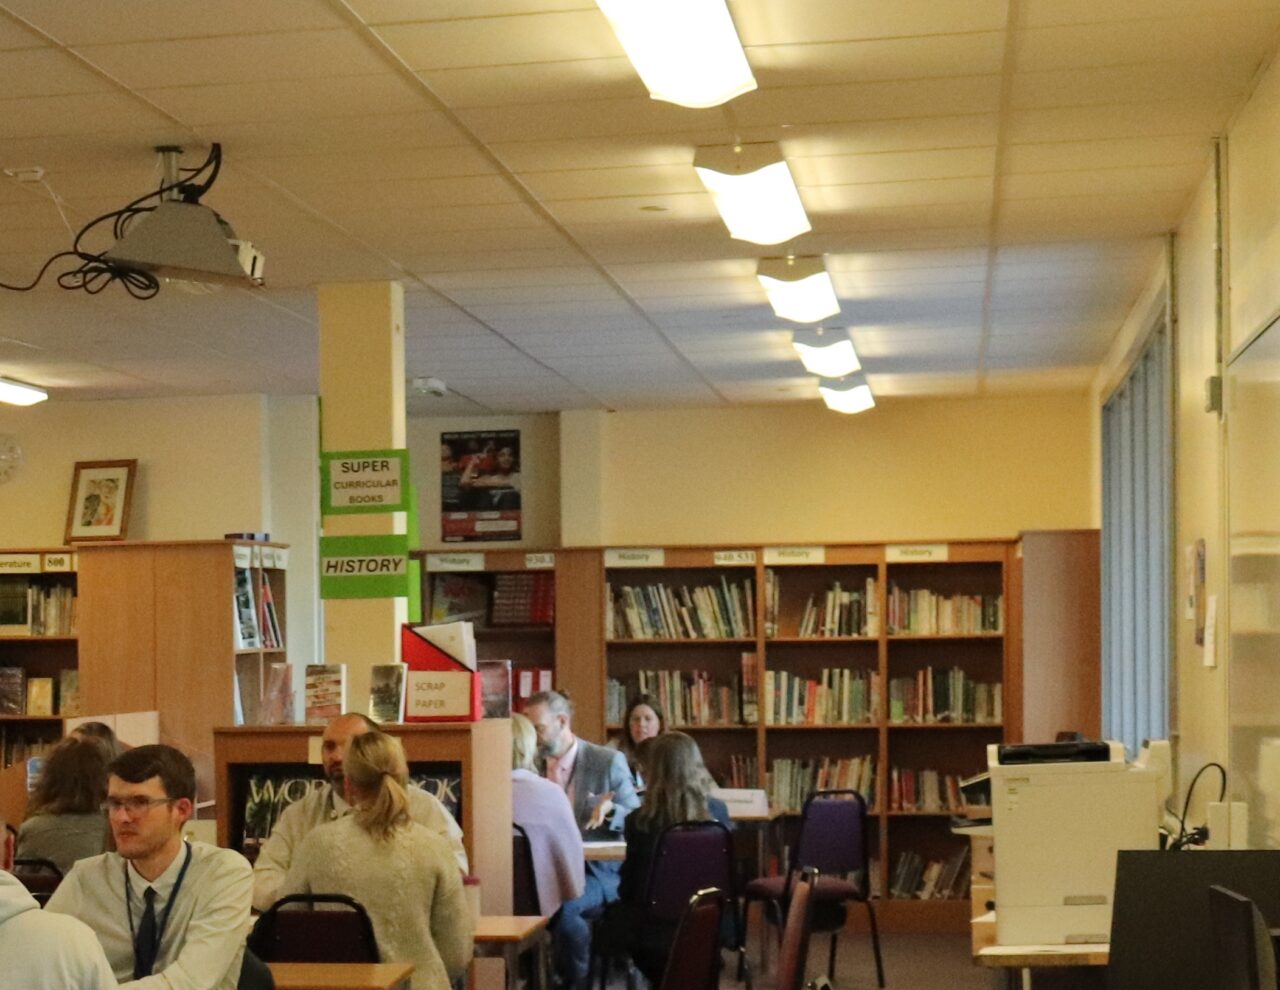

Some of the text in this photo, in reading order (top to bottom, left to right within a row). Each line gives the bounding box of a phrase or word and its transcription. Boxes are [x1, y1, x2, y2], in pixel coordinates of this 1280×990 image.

[341, 460, 390, 473] SUPER
[333, 479, 398, 489] CURRICULAR
[348, 495, 384, 504] BOOKS
[47, 556, 65, 567] 800
[325, 558, 402, 573] HISTORY
[415, 681, 446, 691] SCRAP
[415, 700, 445, 709] PAPER
